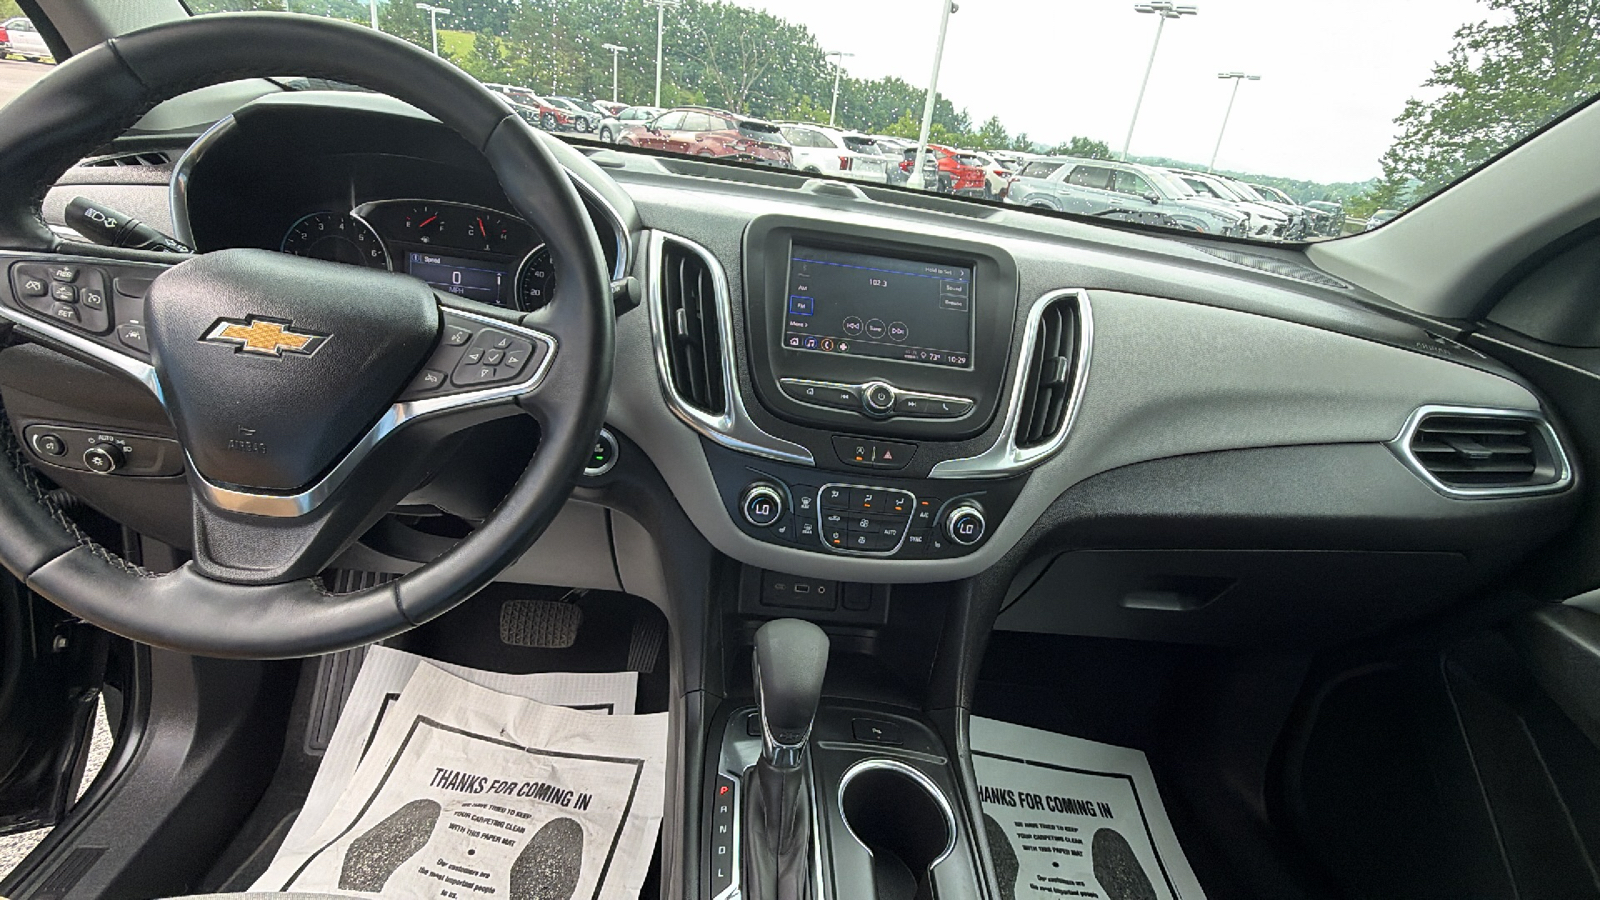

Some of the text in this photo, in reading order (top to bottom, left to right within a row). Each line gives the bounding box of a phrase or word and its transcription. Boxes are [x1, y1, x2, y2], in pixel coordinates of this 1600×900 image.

[424, 255, 441, 264] Speed
[452, 271, 462, 285] 0
[534, 270, 545, 278] 40
[449, 286, 464, 294] MPH
[530, 288, 541, 296] 20
[430, 767, 593, 811] THANKS FOR COMING IN
[720, 786, 729, 795] P
[978, 785, 1114, 819] HANKS FOR COMING IN
[454, 811, 471, 819] YOUR
[505, 823, 526, 834] CLEAN
[719, 825, 727, 834] N
[448, 822, 516, 847] WITH THIS PAPER MAT
[436, 858, 448, 867] Our
[717, 868, 724, 878] L
[418, 866, 429, 875] the
[444, 876, 475, 889] important
[473, 884, 496, 894] people
